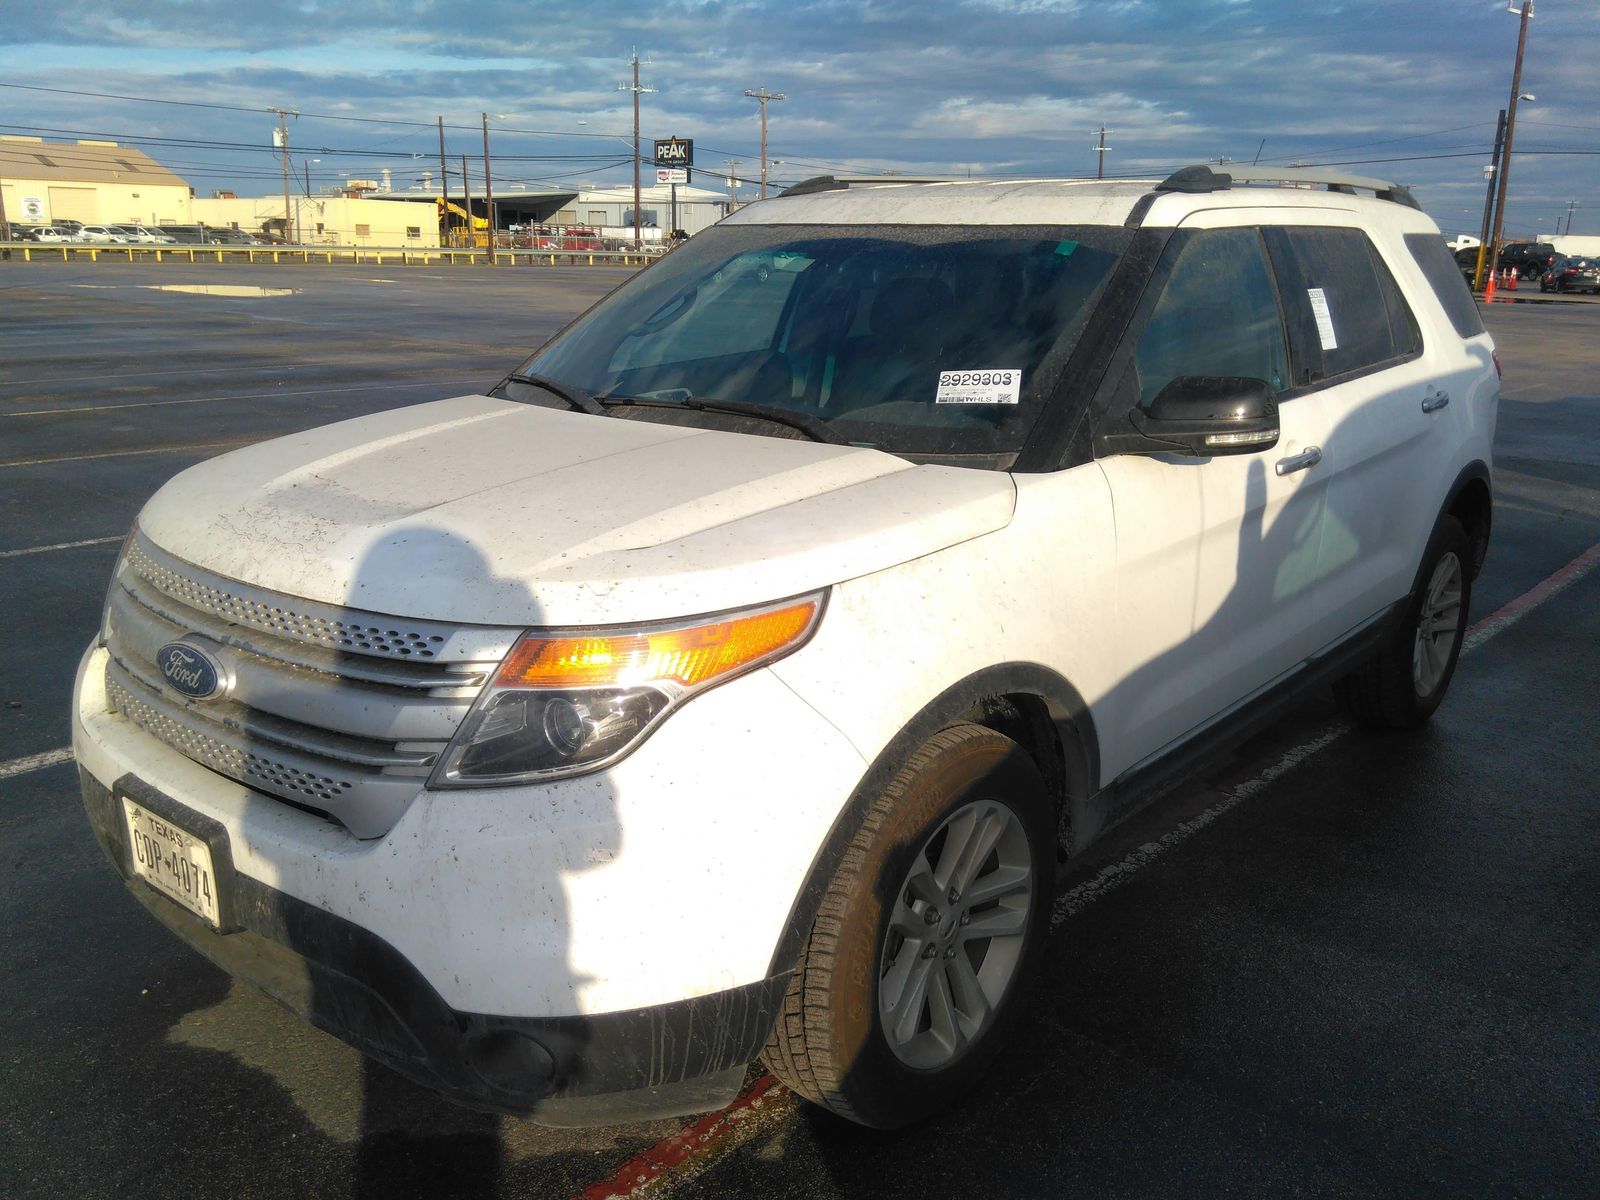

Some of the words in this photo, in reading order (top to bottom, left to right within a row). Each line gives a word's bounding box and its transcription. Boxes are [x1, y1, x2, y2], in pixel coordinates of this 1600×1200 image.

[658, 144, 685, 158] PEAK
[940, 373, 1012, 386] 2929303
[165, 650, 202, 688] Ford
[147, 816, 183, 848] TEXAS
